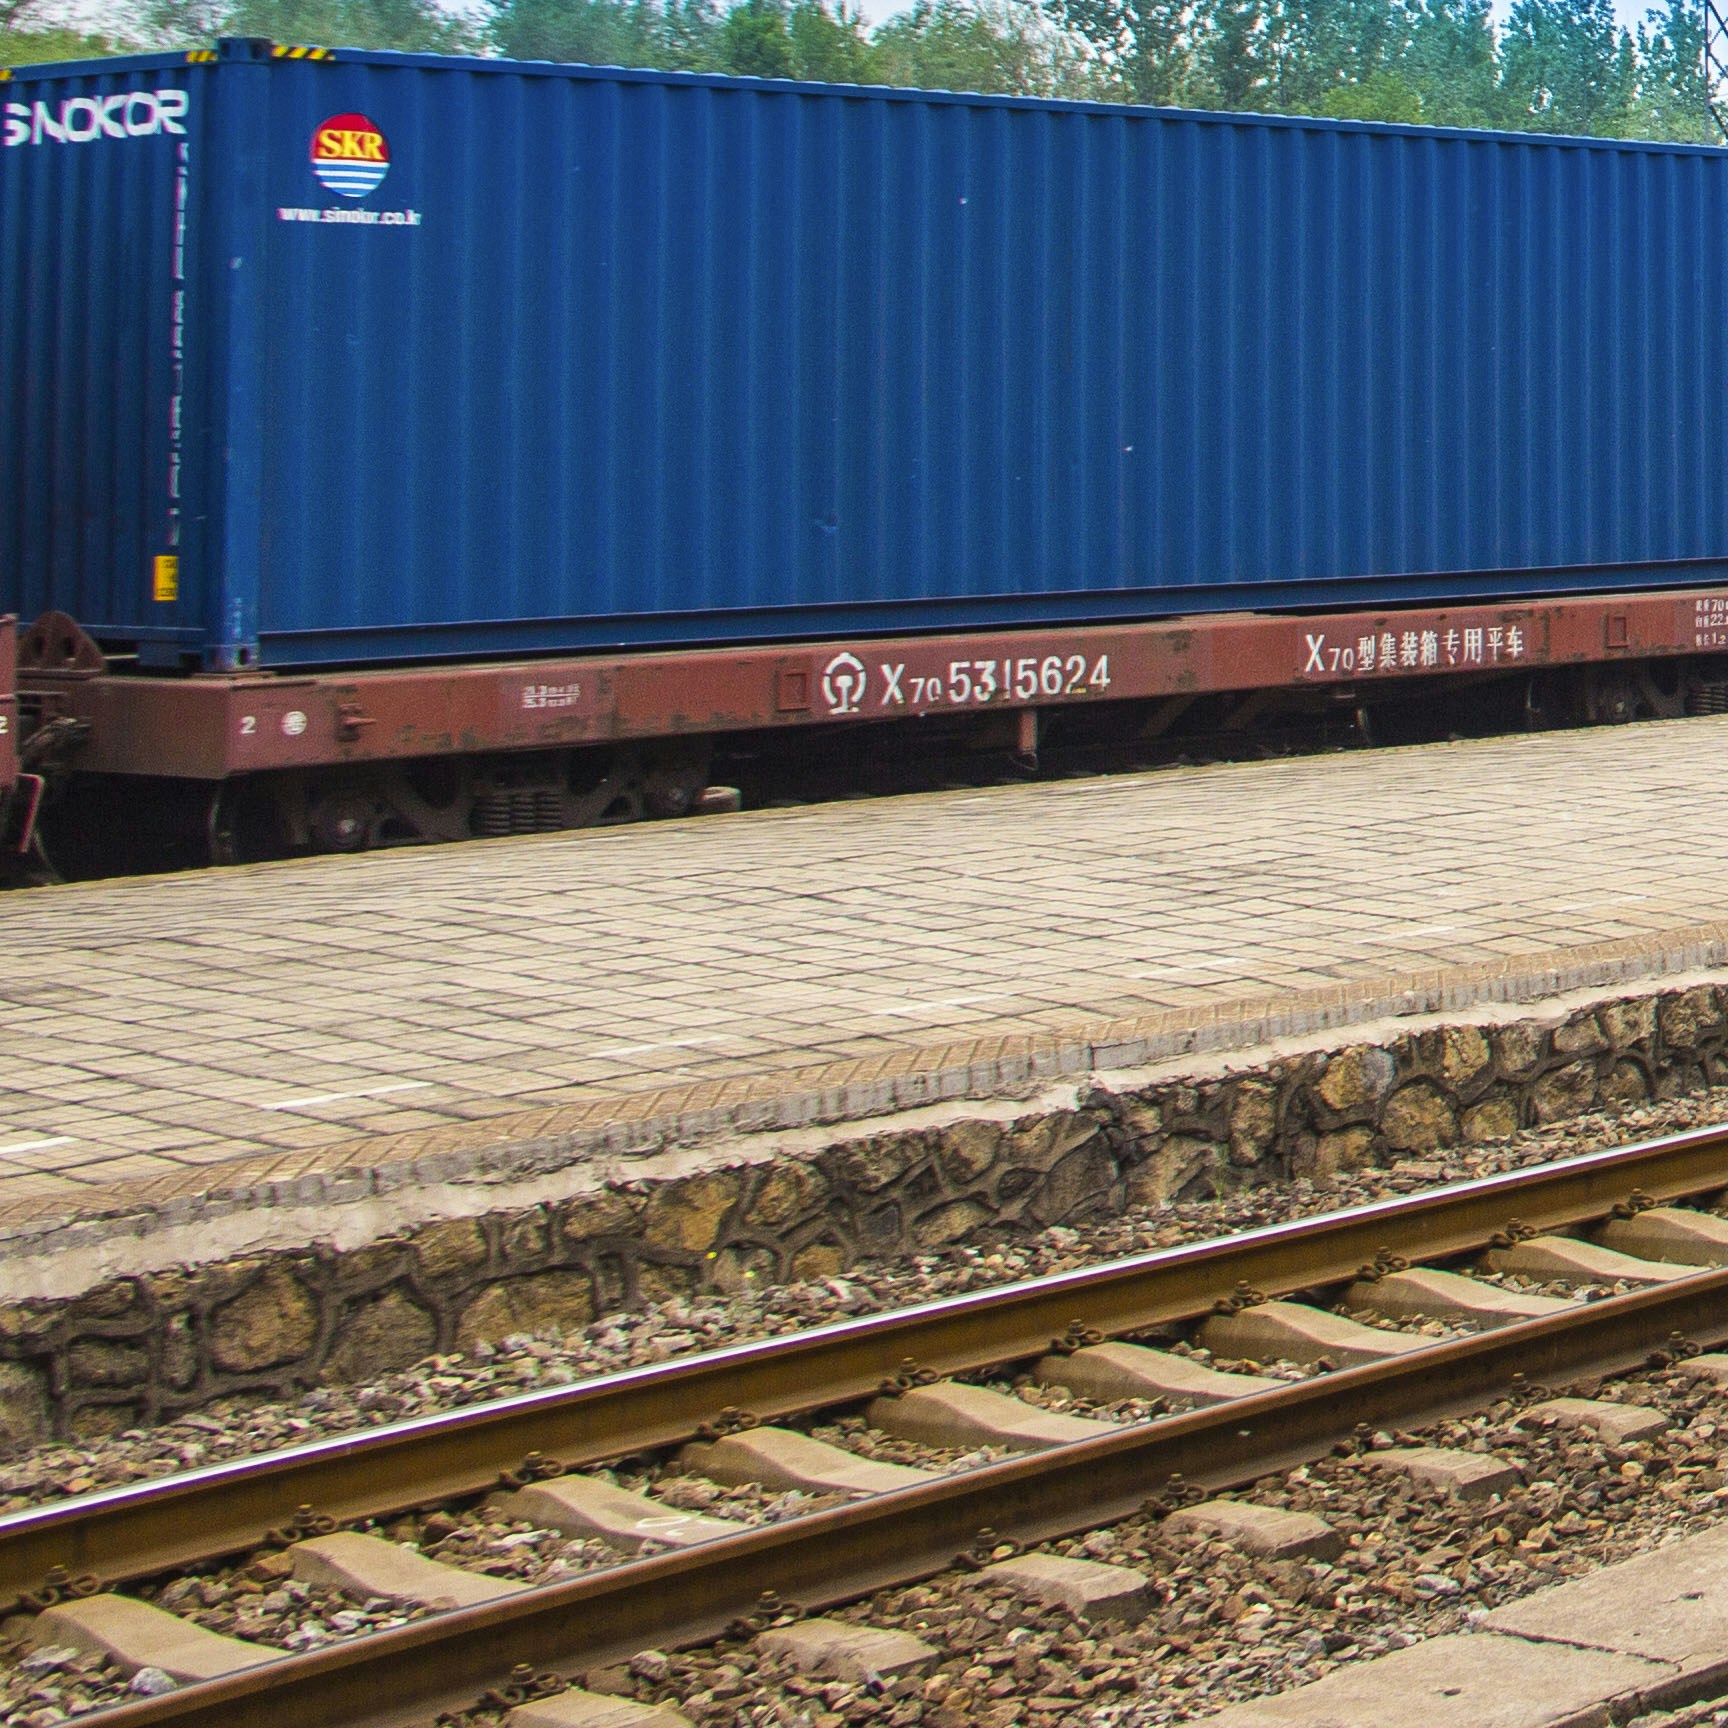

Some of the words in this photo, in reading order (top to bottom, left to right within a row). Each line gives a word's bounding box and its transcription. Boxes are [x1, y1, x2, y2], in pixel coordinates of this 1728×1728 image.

[318, 129, 385, 160] SKR
[949, 655, 1111, 703] 5315624
[239, 715, 256, 734] 2
